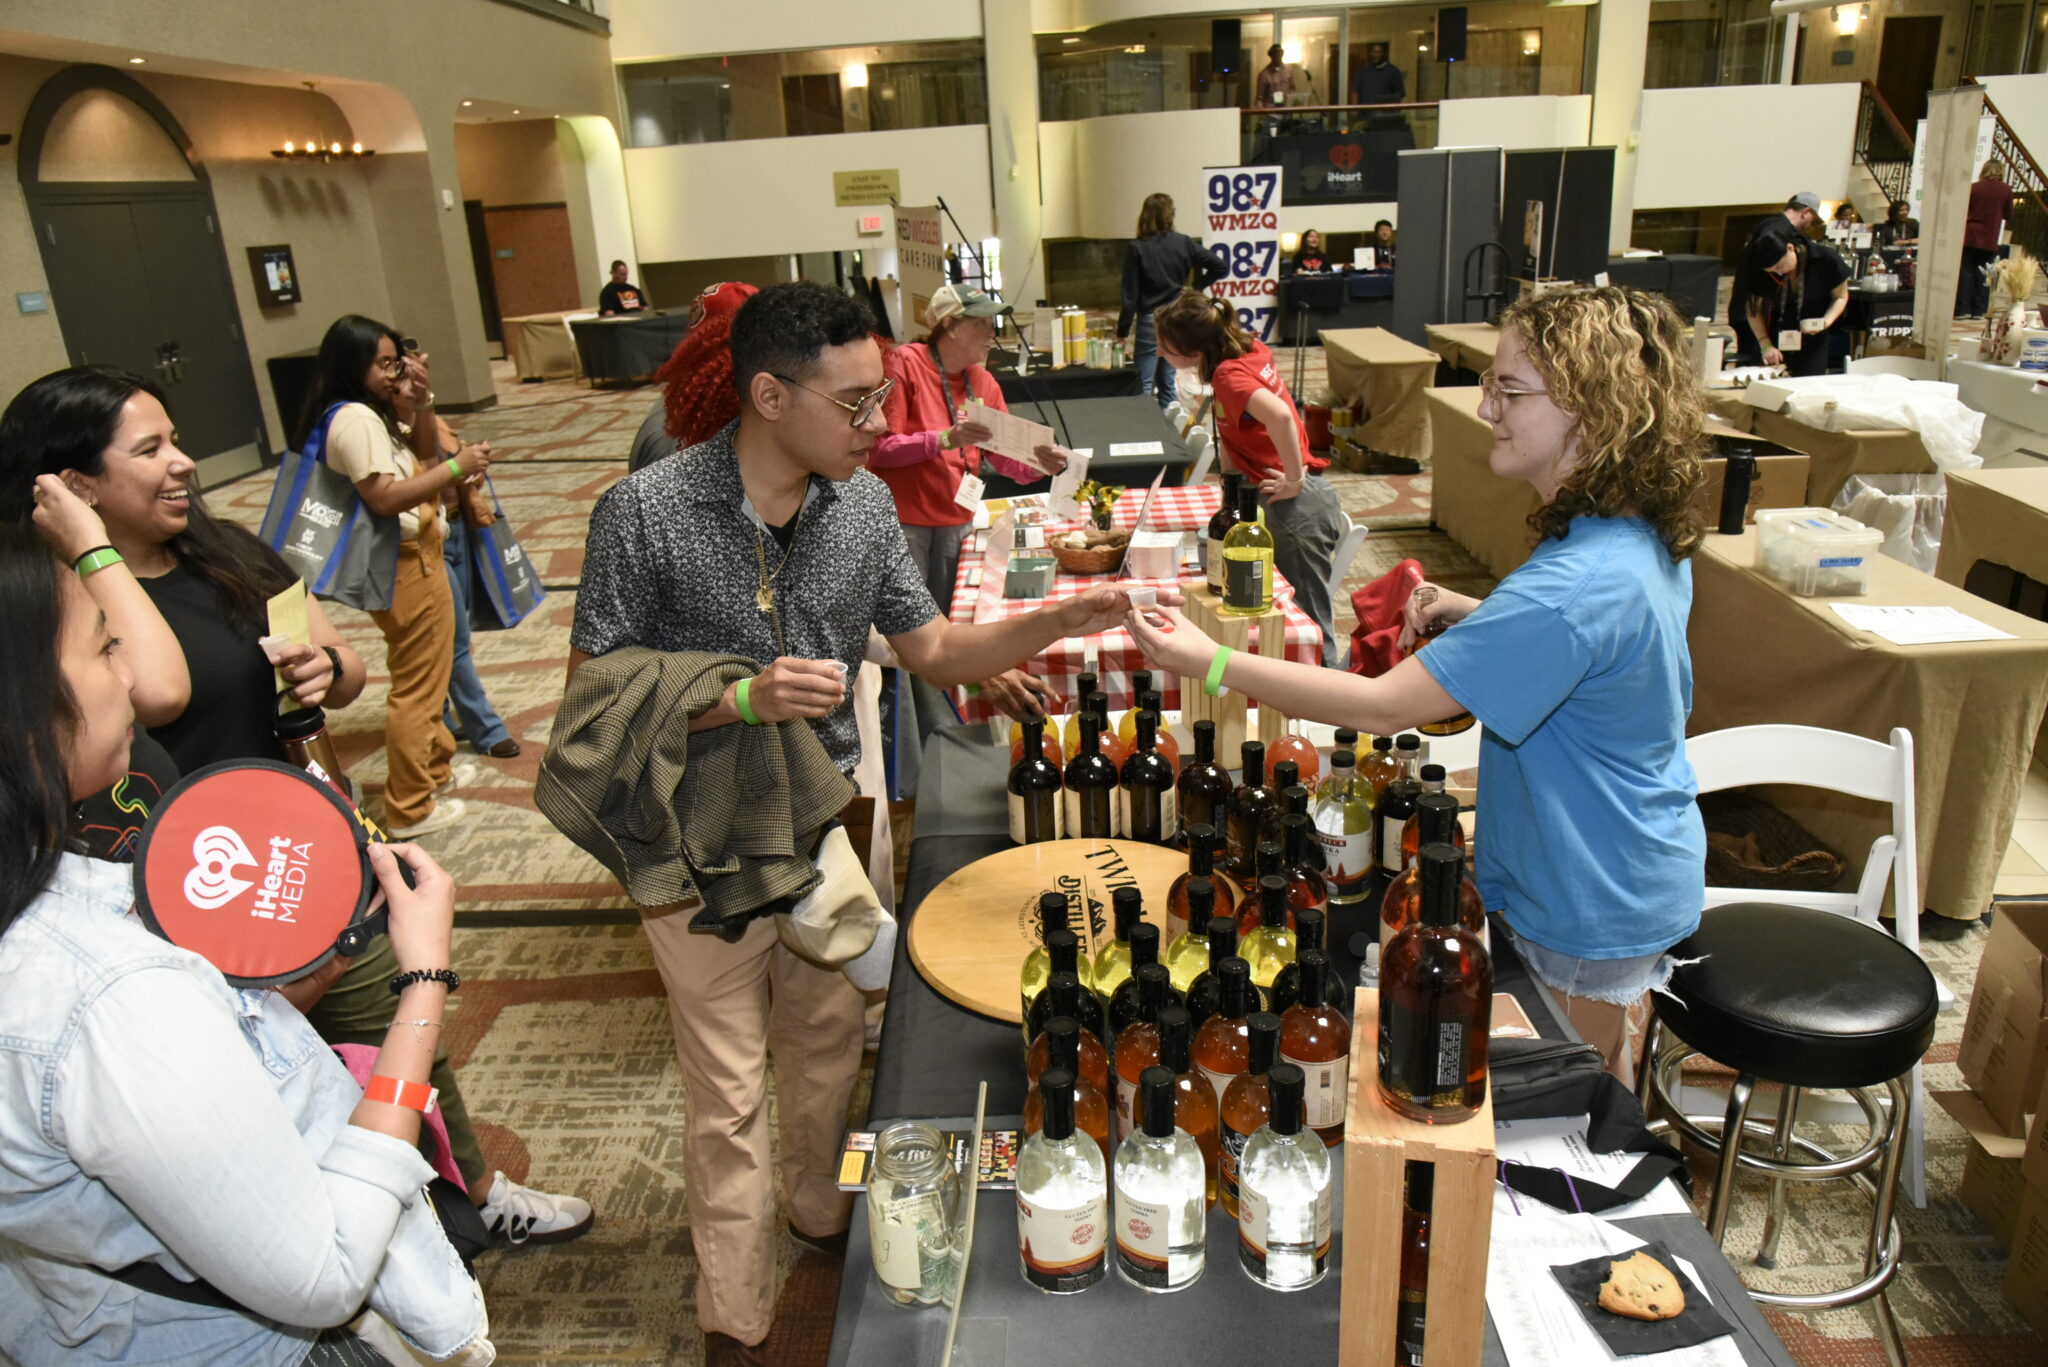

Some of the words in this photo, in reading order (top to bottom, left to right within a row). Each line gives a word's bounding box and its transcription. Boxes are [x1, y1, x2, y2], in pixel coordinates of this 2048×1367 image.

[1327, 172, 1362, 182] iHeart
[863, 216, 880, 230] EXIT
[1208, 212, 1278, 232] WMZQ
[900, 247, 920, 267] CARE
[922, 252, 943, 272] FARM
[1209, 279, 1279, 298] WMZQ
[250, 836, 292, 919] iHeart
[1084, 844, 1138, 894] TWI
[276, 842, 314, 923] MEDIA
